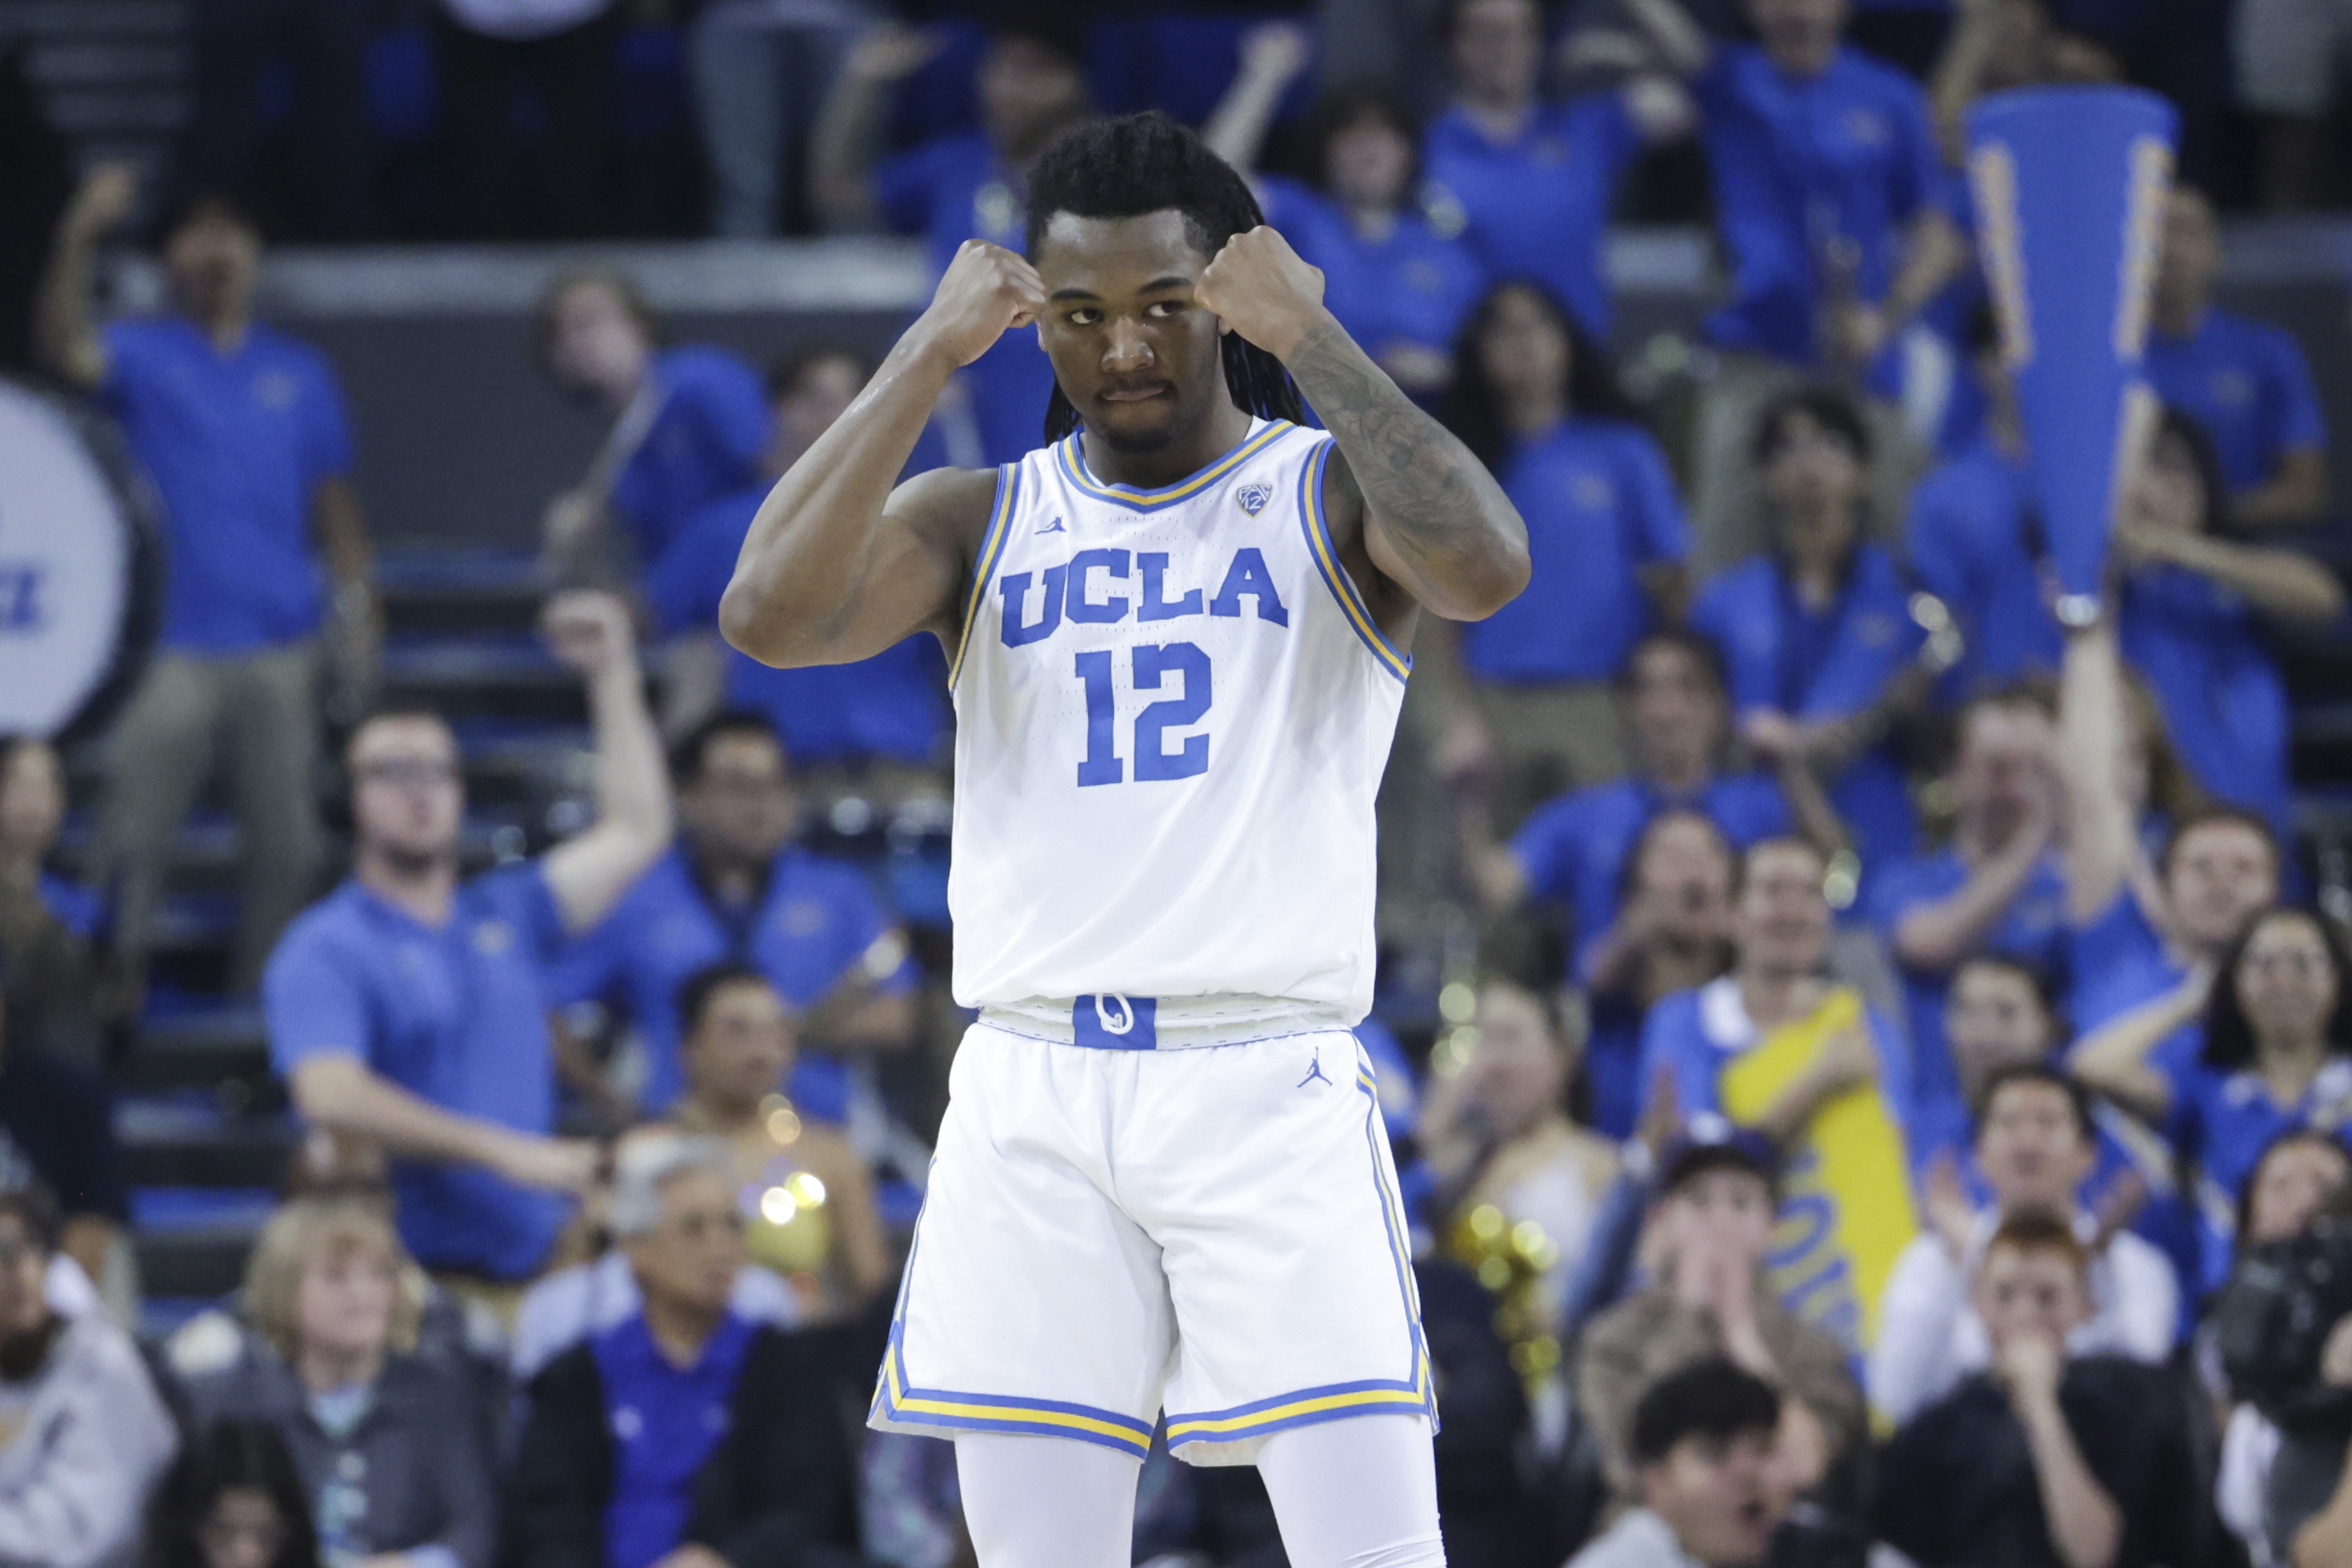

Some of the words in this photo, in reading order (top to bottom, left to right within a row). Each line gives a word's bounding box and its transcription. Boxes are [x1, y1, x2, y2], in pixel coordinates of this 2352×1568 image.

[1244, 496, 1263, 510] 12
[999, 547, 1288, 649] UCLA
[1076, 642, 1212, 786] 12
